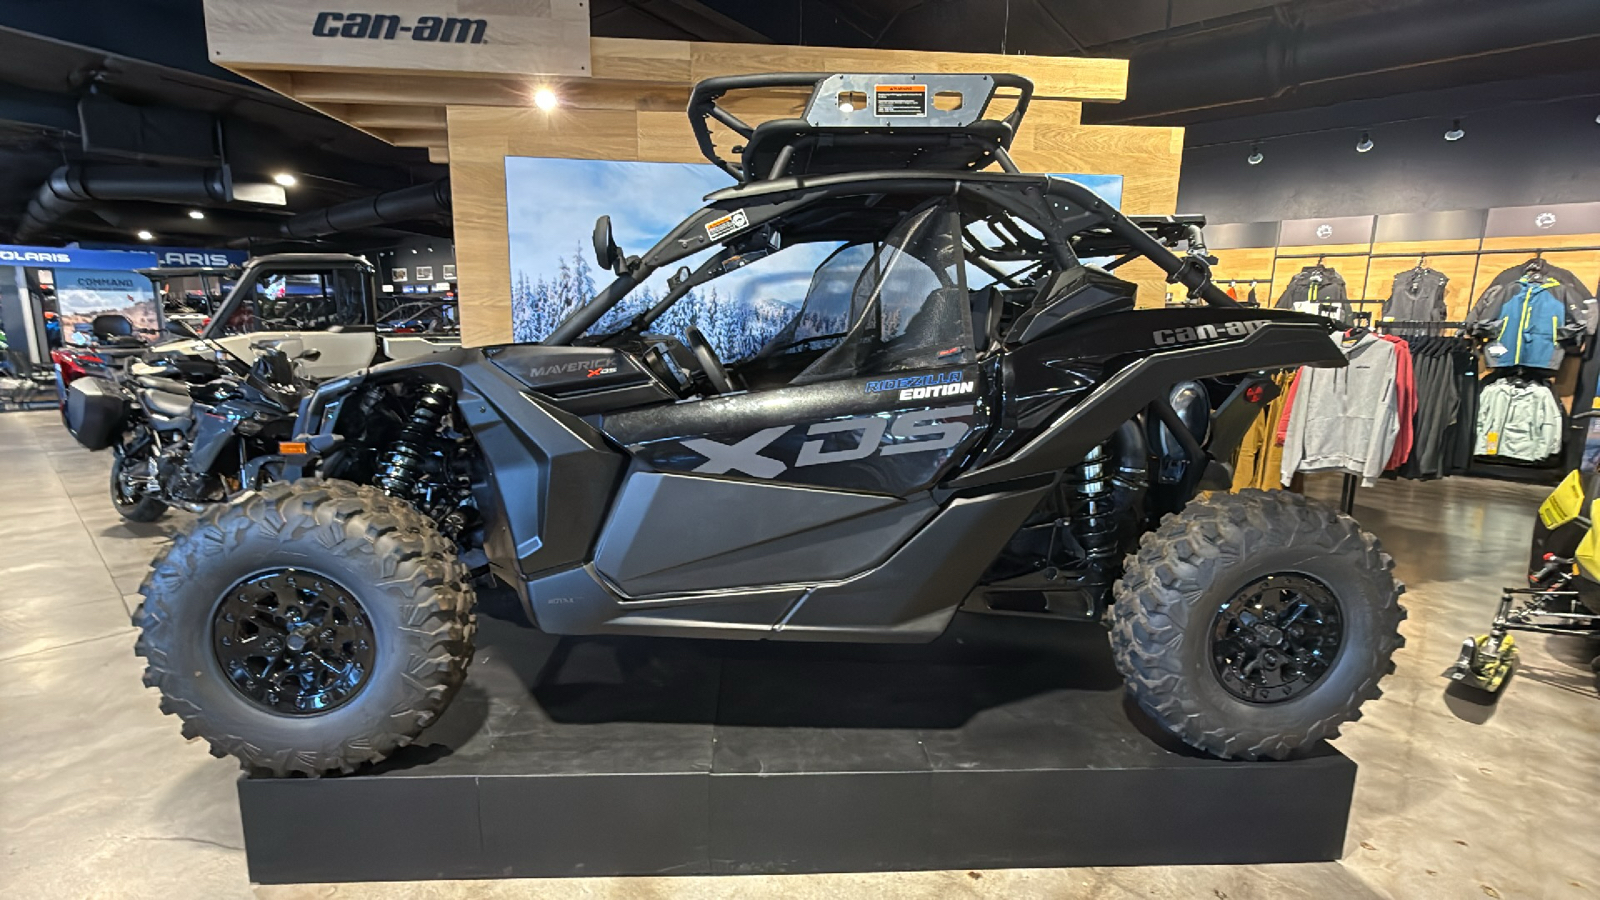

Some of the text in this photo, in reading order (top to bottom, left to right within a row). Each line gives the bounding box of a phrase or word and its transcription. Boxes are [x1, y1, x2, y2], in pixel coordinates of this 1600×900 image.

[312, 12, 488, 44] can-am
[529, 357, 617, 378] MAVERICK
[865, 371, 962, 393] RIDEZILLA
[899, 381, 974, 401] EDITION
